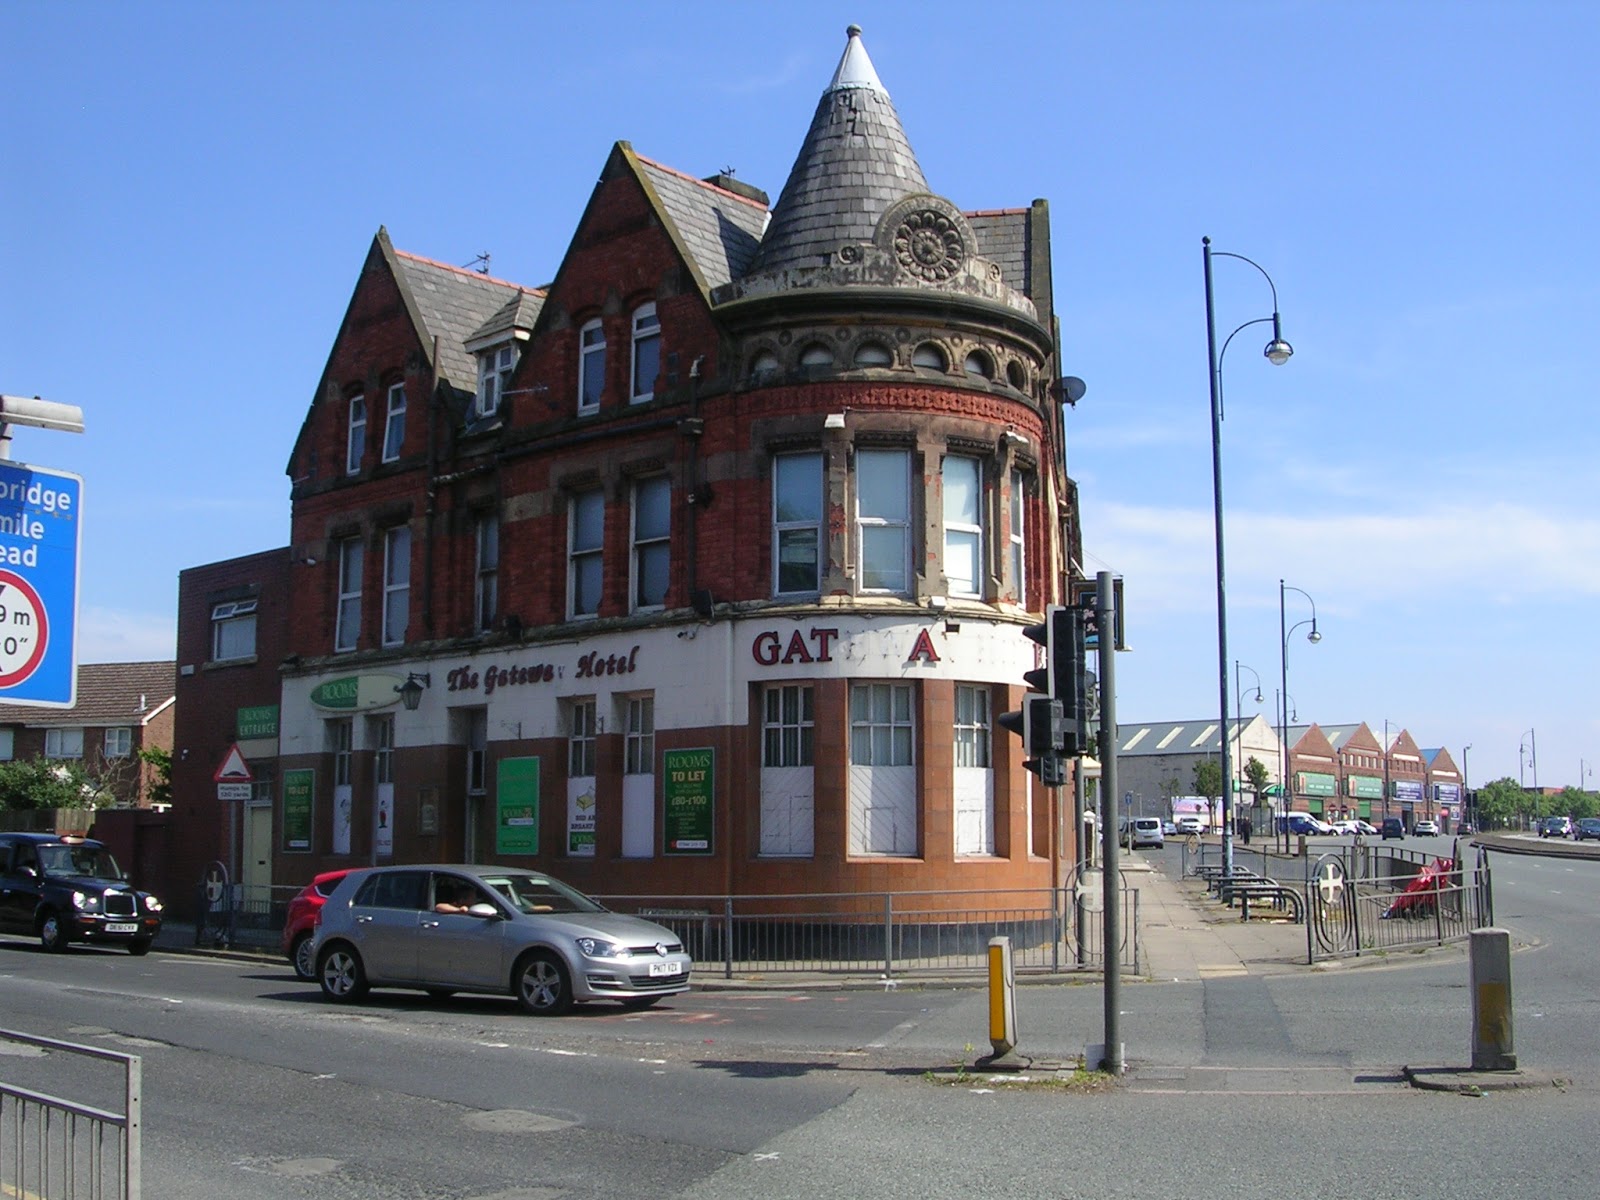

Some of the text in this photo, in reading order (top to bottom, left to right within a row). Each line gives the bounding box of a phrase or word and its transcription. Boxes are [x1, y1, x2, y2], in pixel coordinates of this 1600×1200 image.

[752, 628, 838, 666] GAT
[447, 665, 478, 691] The
[575, 645, 640, 679] Hotel
[321, 682, 358, 699] ROOMS
[244, 709, 272, 721] ROOMS
[239, 723, 276, 736] ENTRANCE
[668, 754, 710, 768] ROOMS
[672, 770, 706, 782] TO LET
